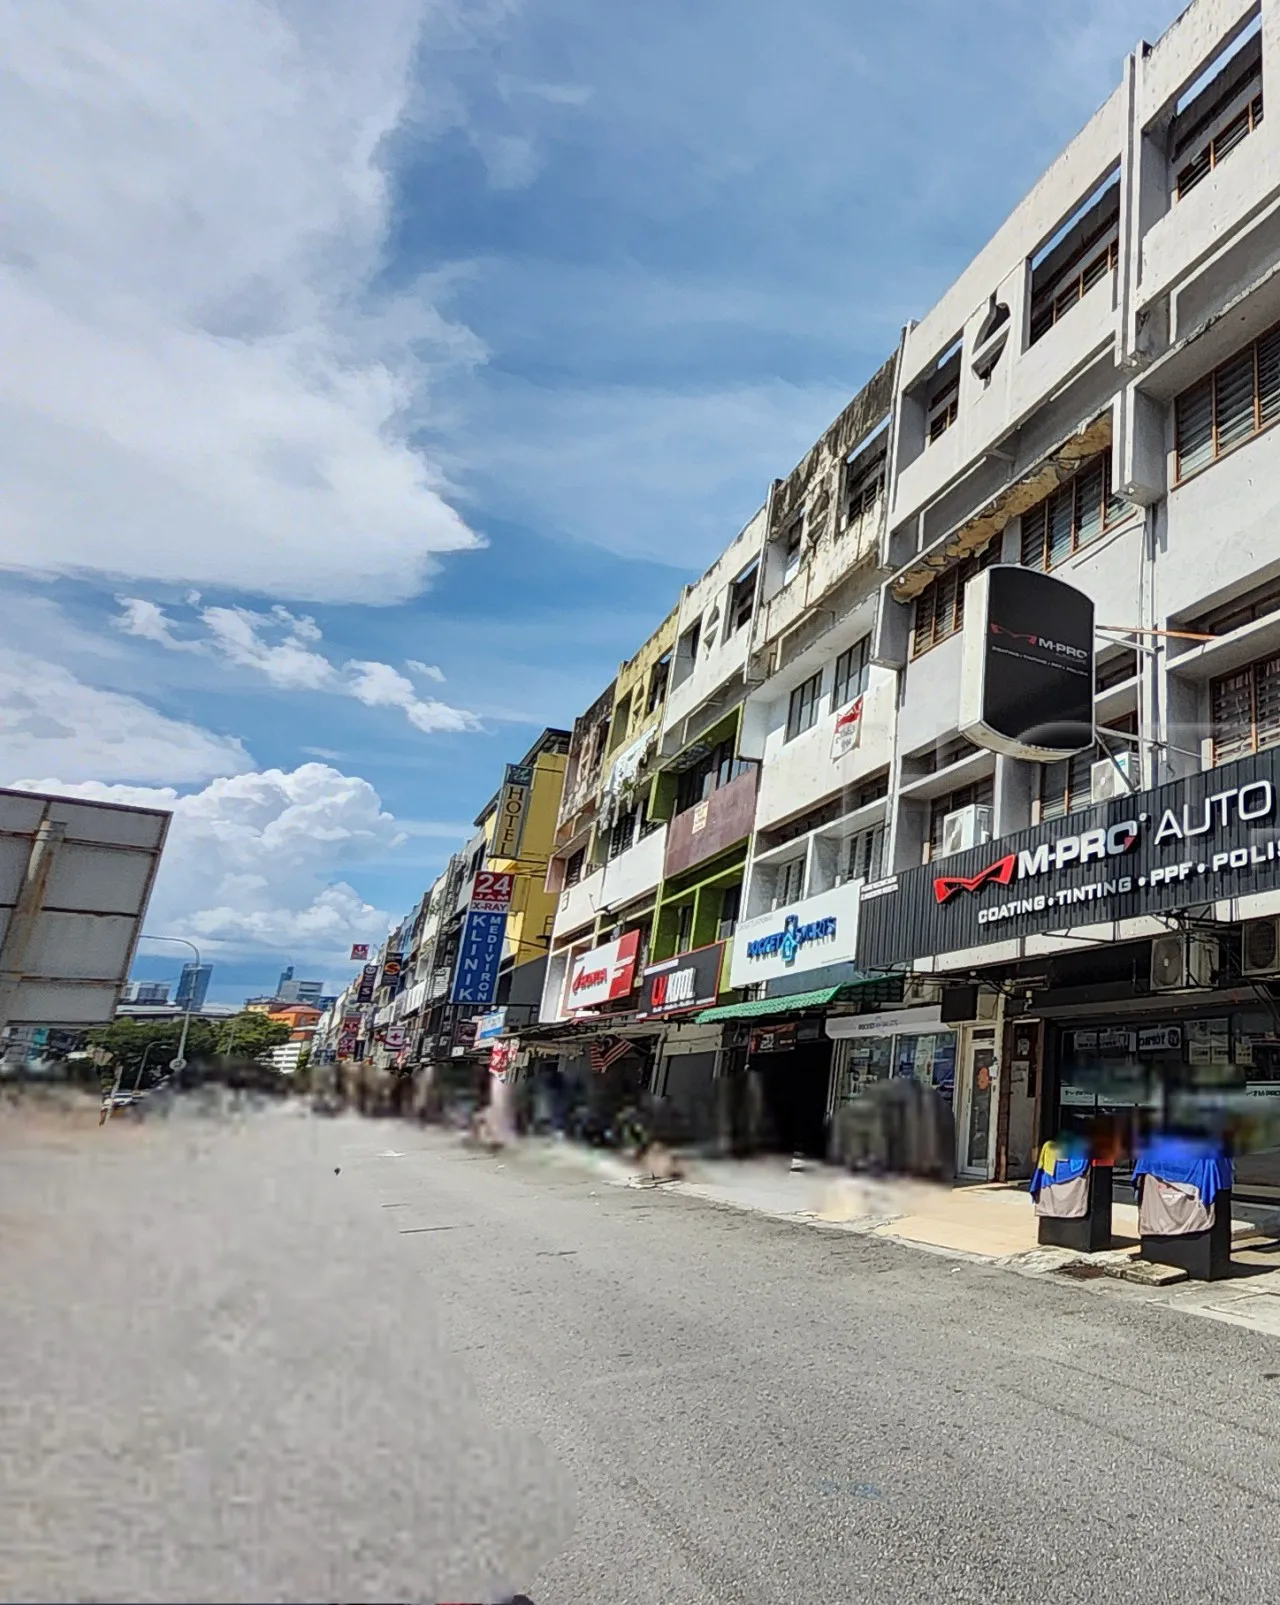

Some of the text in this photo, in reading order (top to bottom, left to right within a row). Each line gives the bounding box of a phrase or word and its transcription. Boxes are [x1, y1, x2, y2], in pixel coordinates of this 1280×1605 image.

[1039, 637, 1087, 659] M-PRO
[500, 786, 524, 856] HOTEL
[1017, 820, 1141, 879] M-PRO
[1153, 780, 1272, 846] AUTO
[472, 901, 508, 912] X-RAY
[476, 873, 511, 895] 24
[977, 895, 1045, 926] COATING
[1055, 875, 1132, 907] TINTING
[1150, 861, 1193, 888] PPF
[457, 914, 487, 1001] KLINIK
[477, 915, 502, 1001] MEDIVIRON
